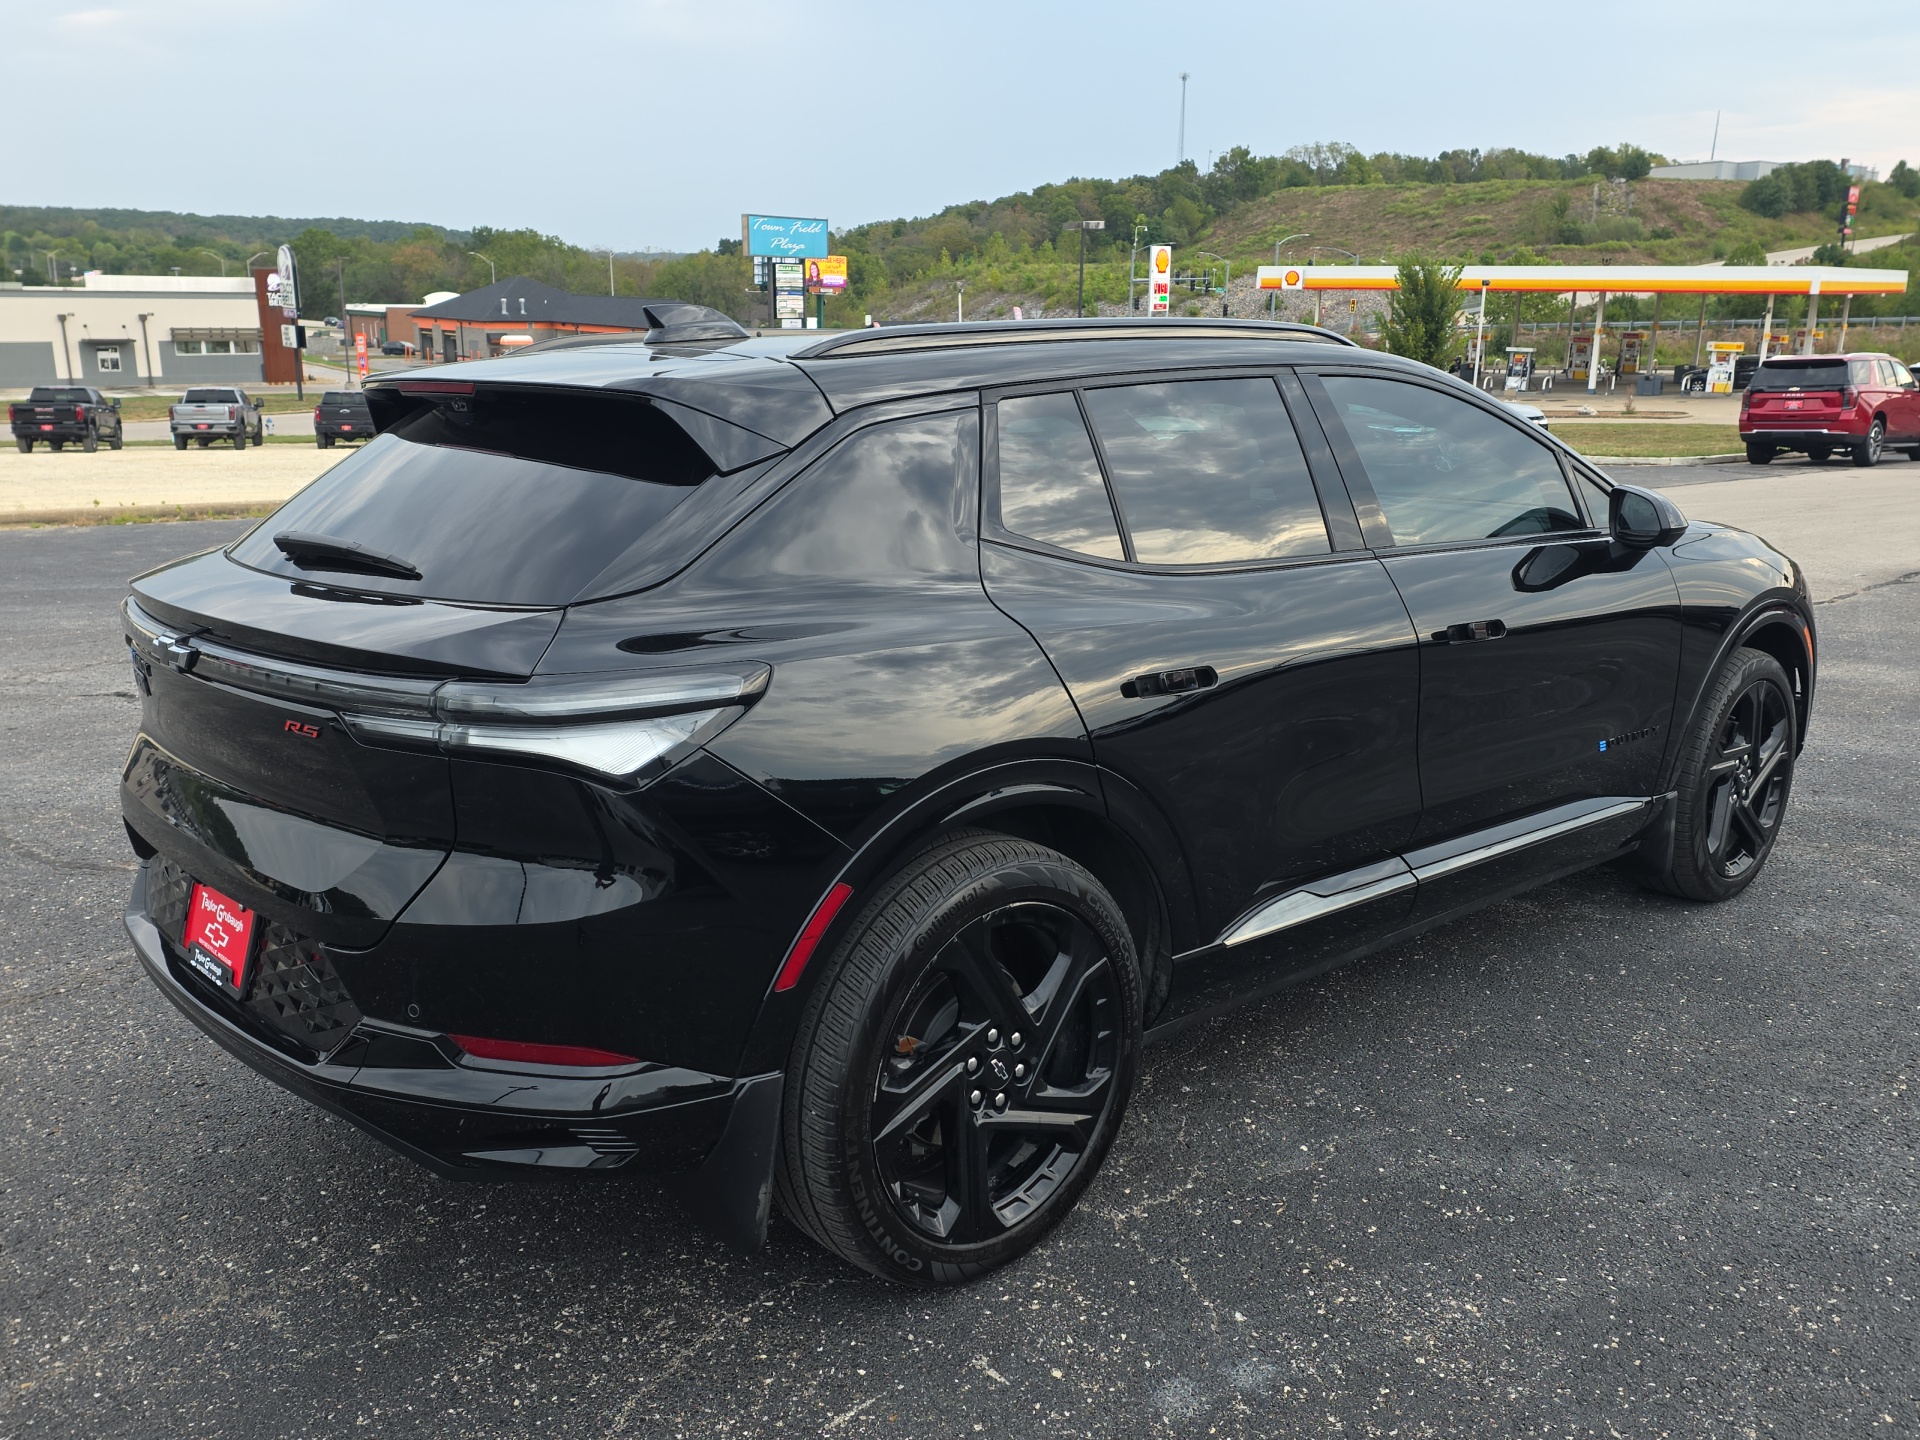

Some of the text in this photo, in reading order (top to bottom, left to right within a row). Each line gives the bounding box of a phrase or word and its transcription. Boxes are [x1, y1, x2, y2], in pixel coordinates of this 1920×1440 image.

[754, 218, 822, 234] Town Field
[771, 237, 805, 254] Plaza
[284, 719, 319, 738] RS
[202, 891, 244, 932] Taylor Grubaugh
[914, 887, 980, 953] Continental
